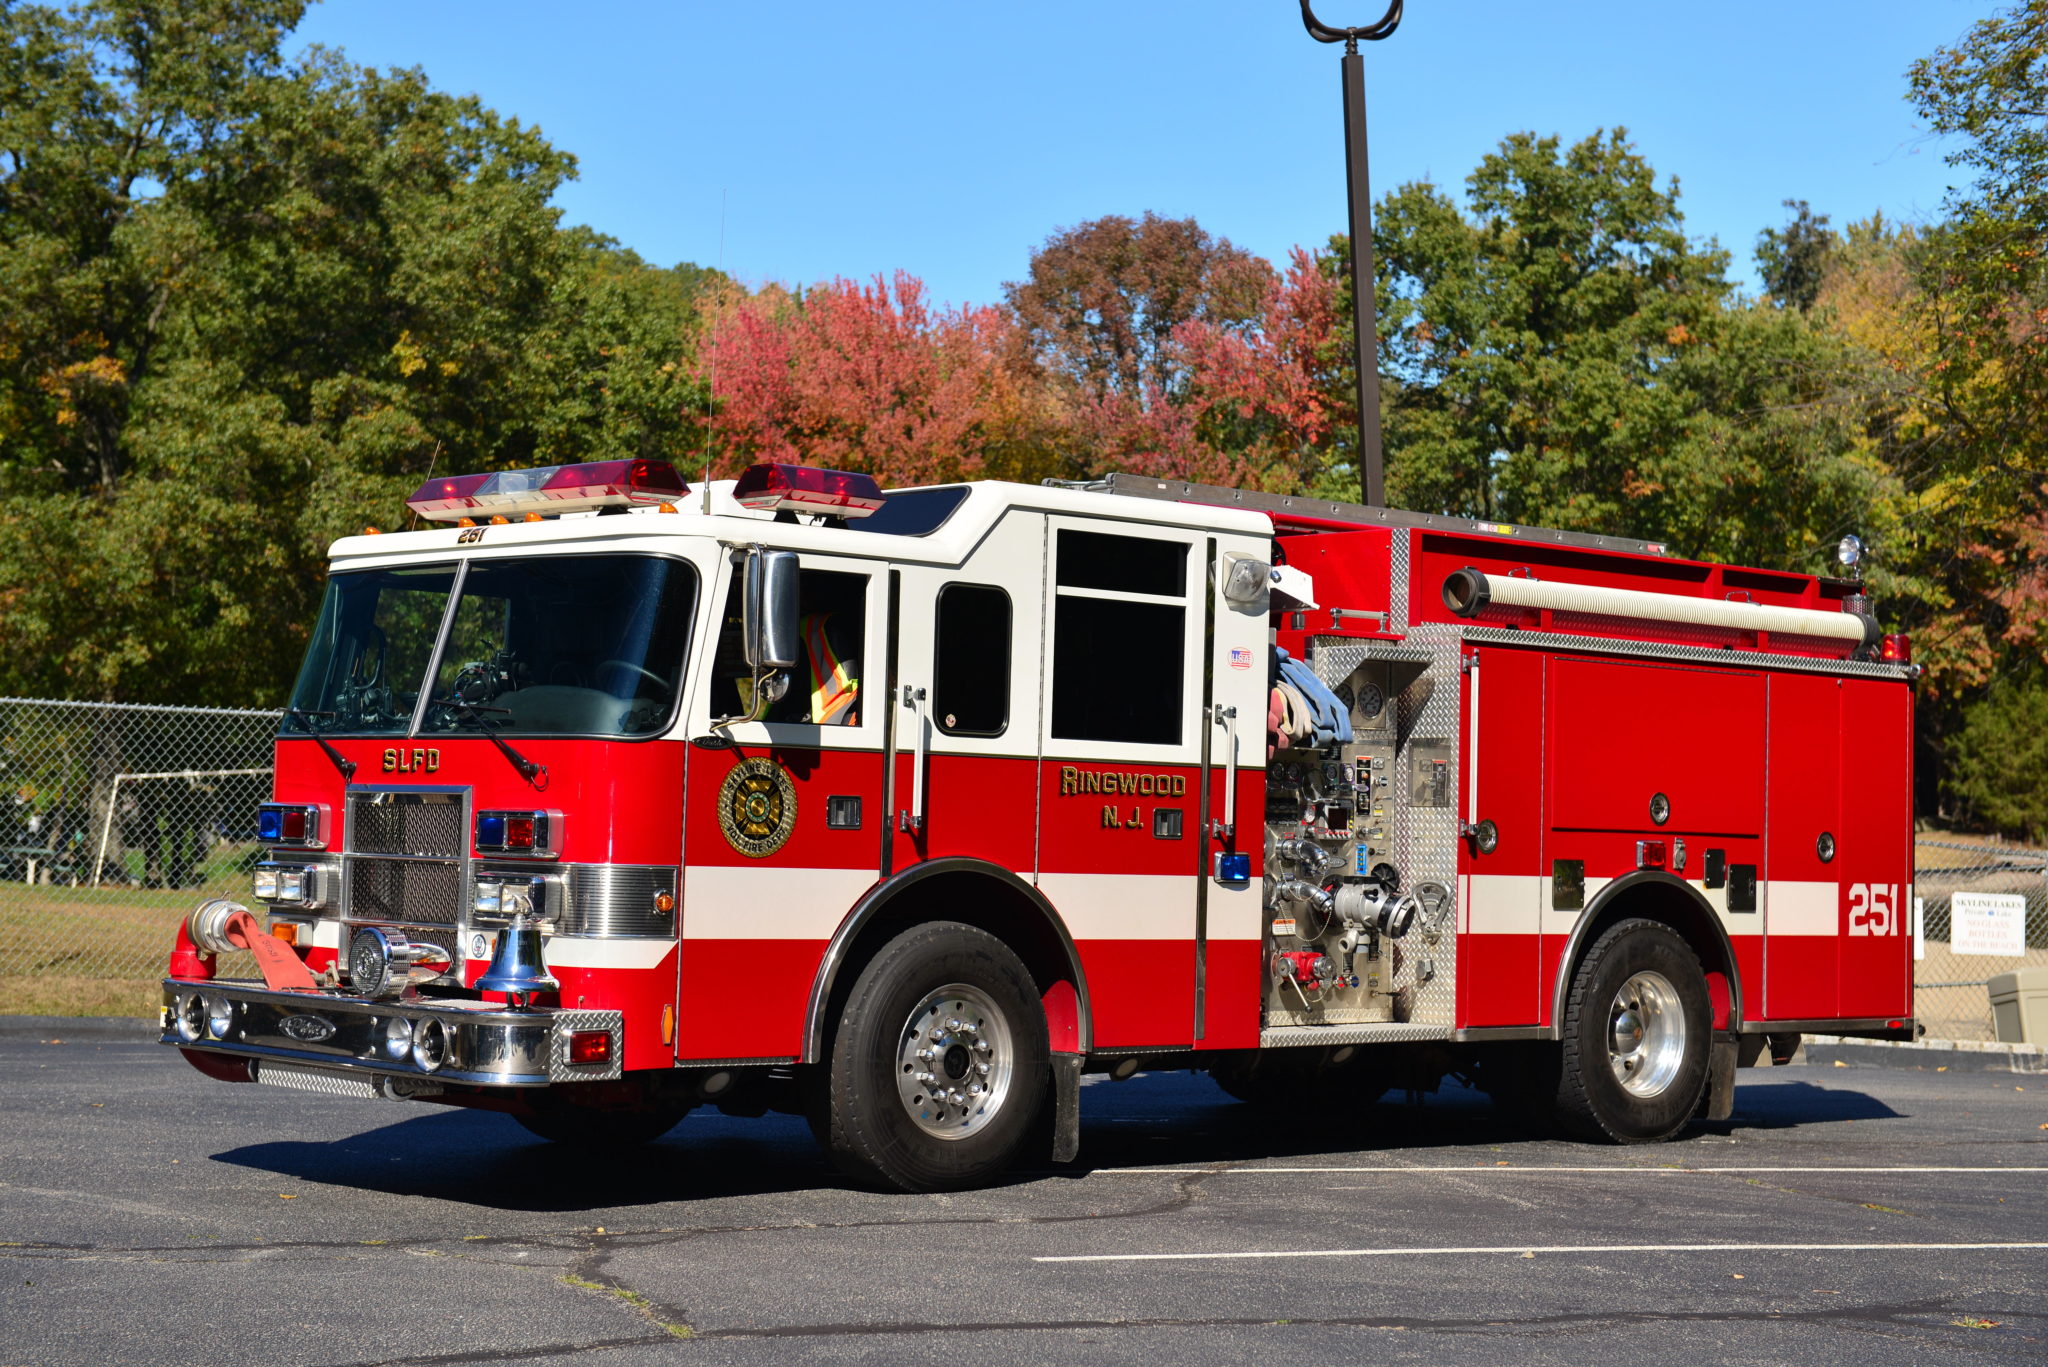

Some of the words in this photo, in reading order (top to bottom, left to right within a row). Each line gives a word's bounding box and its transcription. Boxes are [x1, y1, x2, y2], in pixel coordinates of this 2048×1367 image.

[457, 527, 489, 544] 251
[383, 748, 440, 773] SLFD
[727, 762, 761, 791] SKYLINE
[766, 764, 789, 793] LAKES
[1061, 766, 1186, 797] RINGWOOD
[743, 840, 763, 852] FIRE
[1848, 883, 1899, 937] 251
[1956, 899, 1992, 908] SKYLINE
[1995, 900, 2021, 909] LAKES
